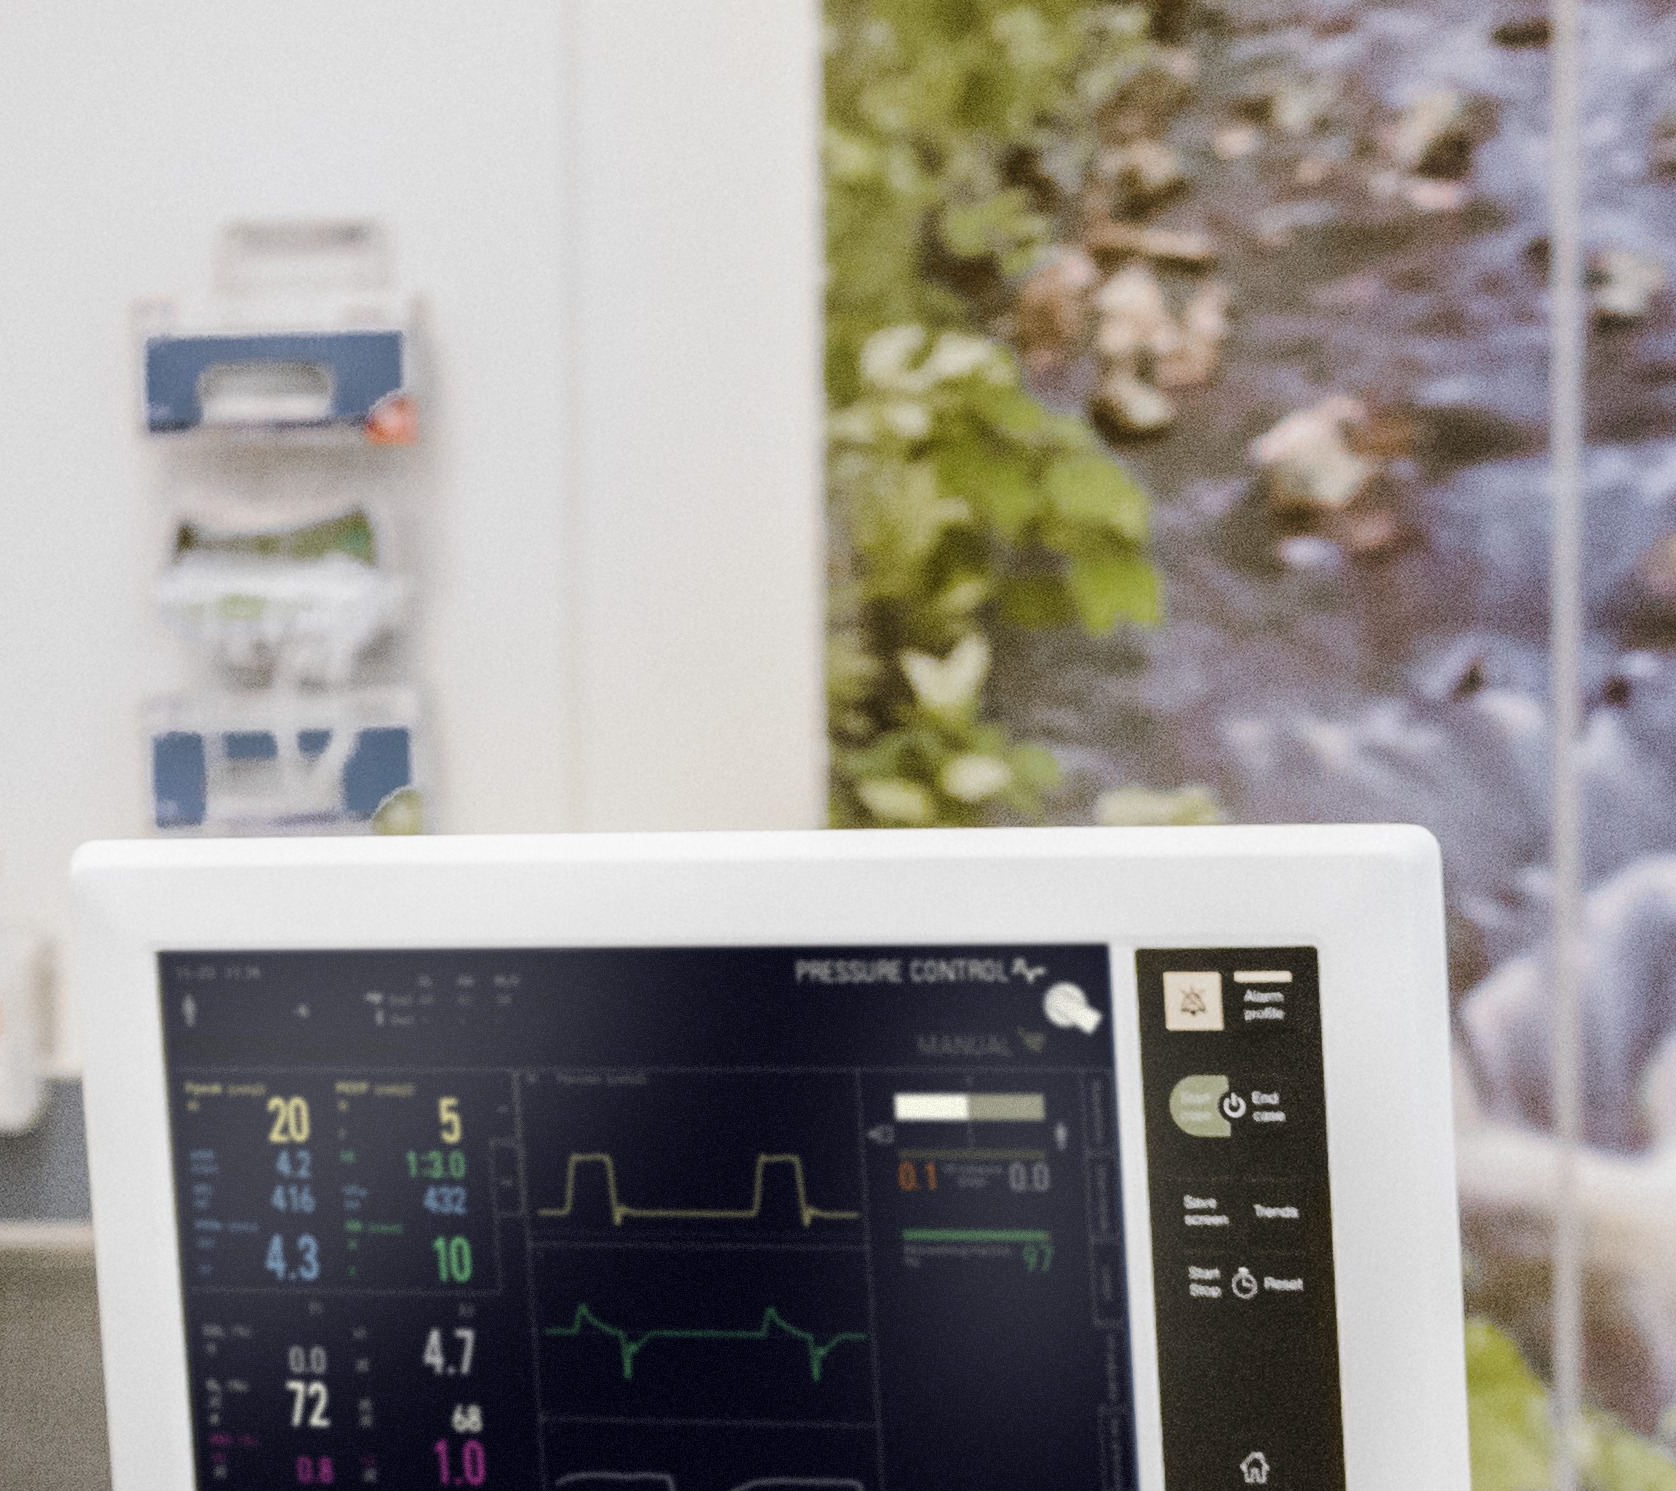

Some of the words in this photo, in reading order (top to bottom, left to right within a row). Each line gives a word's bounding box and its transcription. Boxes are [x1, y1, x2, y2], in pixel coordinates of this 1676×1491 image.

[795, 958, 902, 984] PRESSURE
[909, 958, 1009, 983] CONTROL
[267, 1095, 311, 1144] 20
[438, 1096, 462, 1144] 5
[276, 1150, 312, 1179] 4.2
[898, 1161, 939, 1191] 0.1
[1008, 1161, 1050, 1192] 0.0
[270, 1184, 316, 1213] 416
[423, 1186, 467, 1216] 432
[265, 1234, 321, 1282] 4.3
[433, 1235, 473, 1283] 10
[288, 1345, 328, 1375] 0.0
[423, 1326, 476, 1375] 4.7
[285, 1381, 331, 1428] 72
[451, 1404, 483, 1434] 68
[434, 1439, 486, 1486] 1.0
